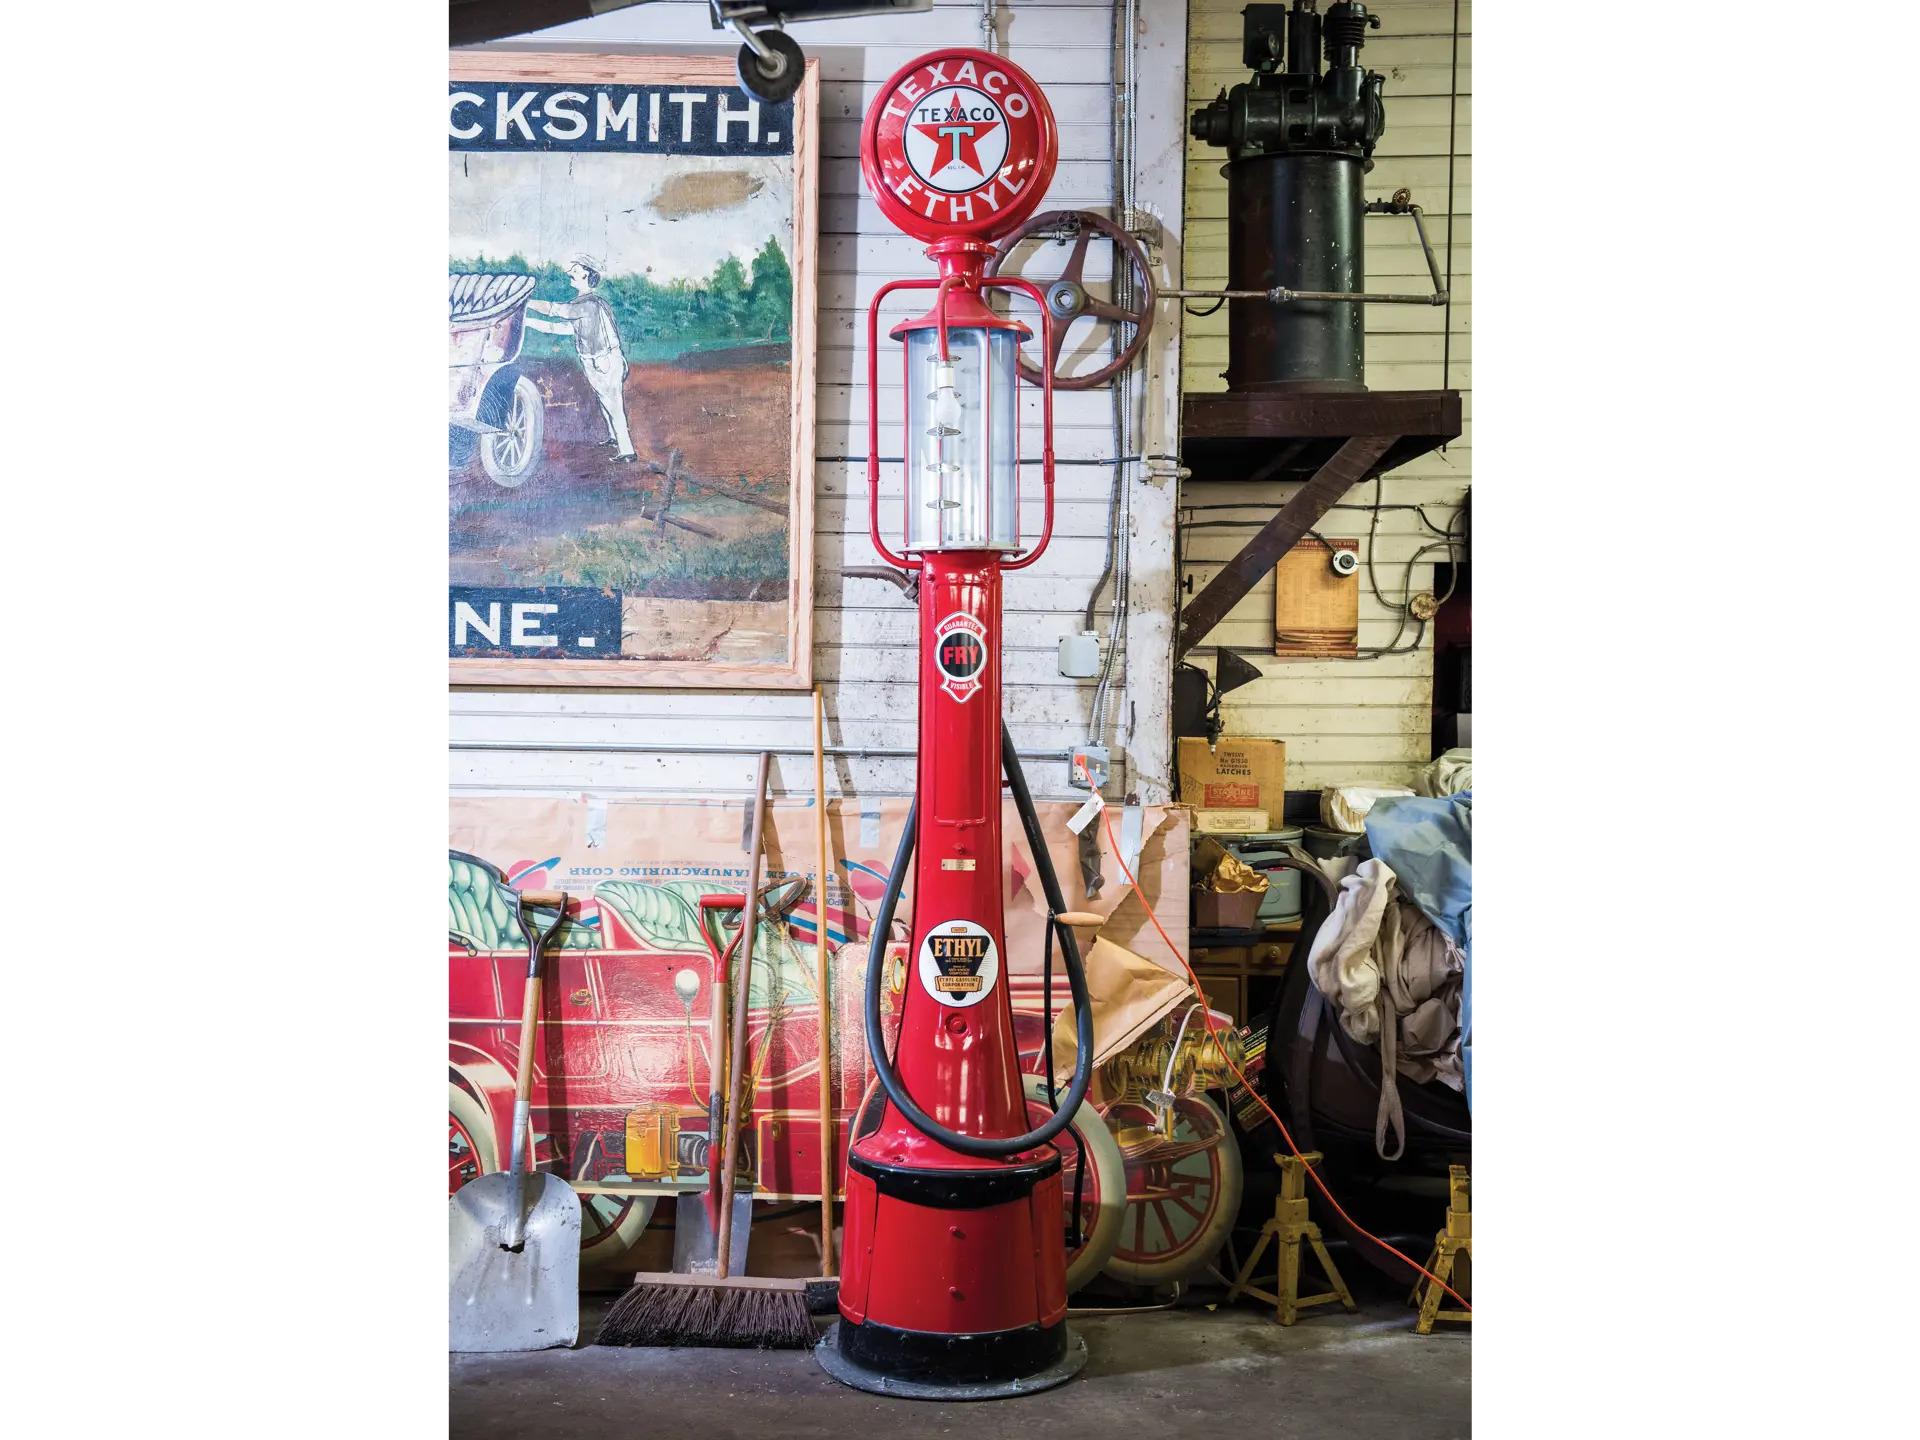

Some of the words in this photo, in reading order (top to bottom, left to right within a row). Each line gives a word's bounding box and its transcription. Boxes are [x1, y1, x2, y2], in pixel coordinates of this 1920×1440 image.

[882, 60, 1029, 121] TEXACO
[919, 107, 995, 123] TEXACO
[938, 125, 975, 161] T
[894, 174, 1026, 222] ETHYL
[454, 601, 596, 648] NE.
[944, 620, 979, 632] GUARANTEE
[943, 645, 979, 665] FRY
[950, 681, 974, 691] VISIBLE
[802, 896, 850, 906] IMPOANT
[934, 938, 985, 957] ETHYL
